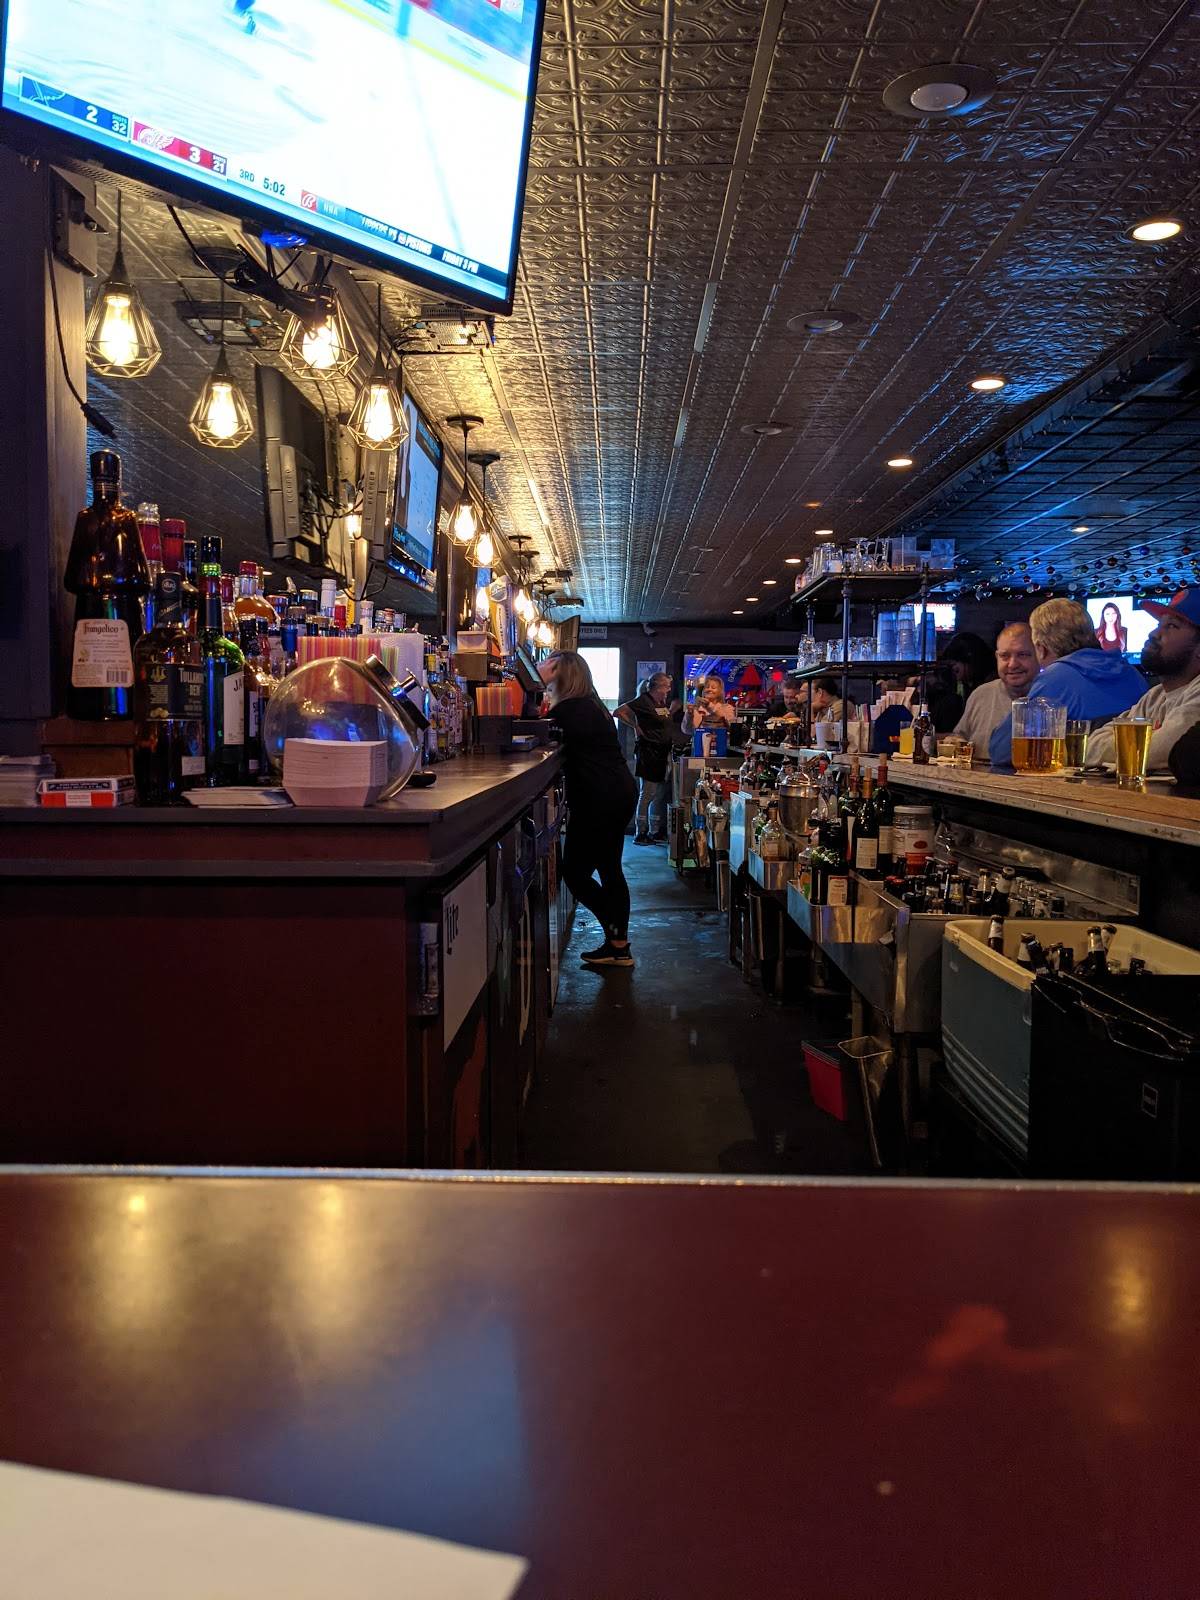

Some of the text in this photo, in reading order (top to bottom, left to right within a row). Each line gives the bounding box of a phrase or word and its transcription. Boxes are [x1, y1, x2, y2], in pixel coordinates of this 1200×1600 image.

[86, 105, 98, 123] 2
[111, 120, 127, 135] 32
[188, 145, 200, 163] 3
[212, 160, 225, 174] 21
[240, 169, 285, 196] 3RD 5:02
